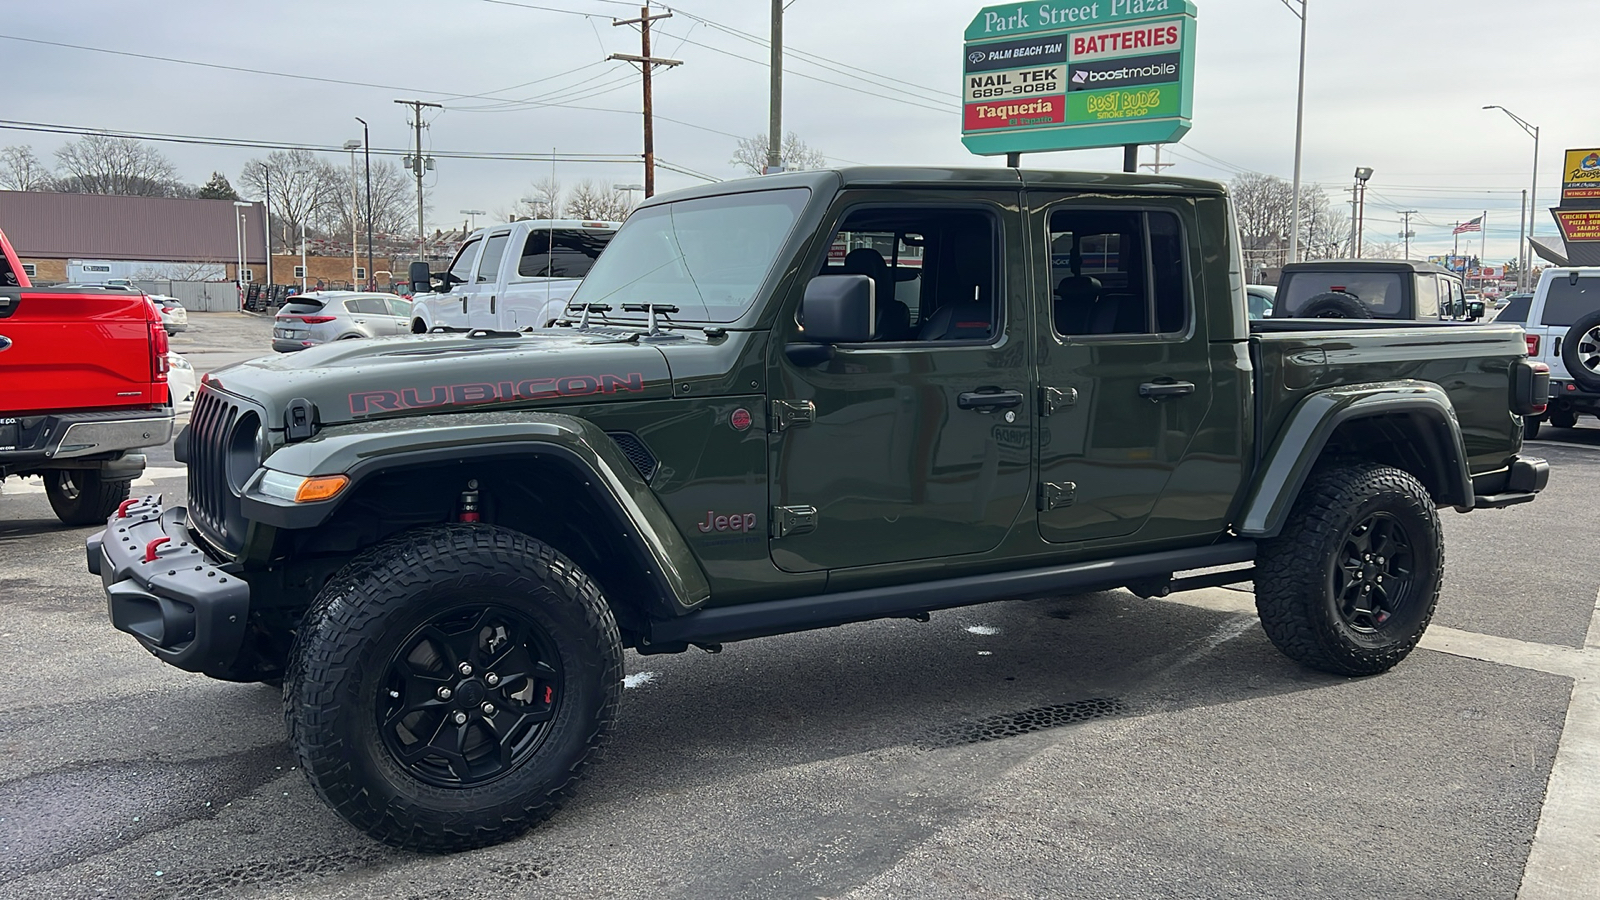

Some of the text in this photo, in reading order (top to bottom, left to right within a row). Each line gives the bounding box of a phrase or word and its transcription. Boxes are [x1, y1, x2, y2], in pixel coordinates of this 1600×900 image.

[984, 0, 1169, 33] Park Street Plaza
[1074, 26, 1178, 55] BATTERIES
[988, 43, 1062, 61] PALM BEACH TAN
[970, 68, 1058, 88] NAIL TEK
[972, 82, 1057, 99] 689-9088
[1122, 88, 1160, 110] BUDZ
[1097, 108, 1148, 119] SMOKE SHOP
[349, 373, 643, 414] RUBICON
[698, 511, 757, 533] Jeep
